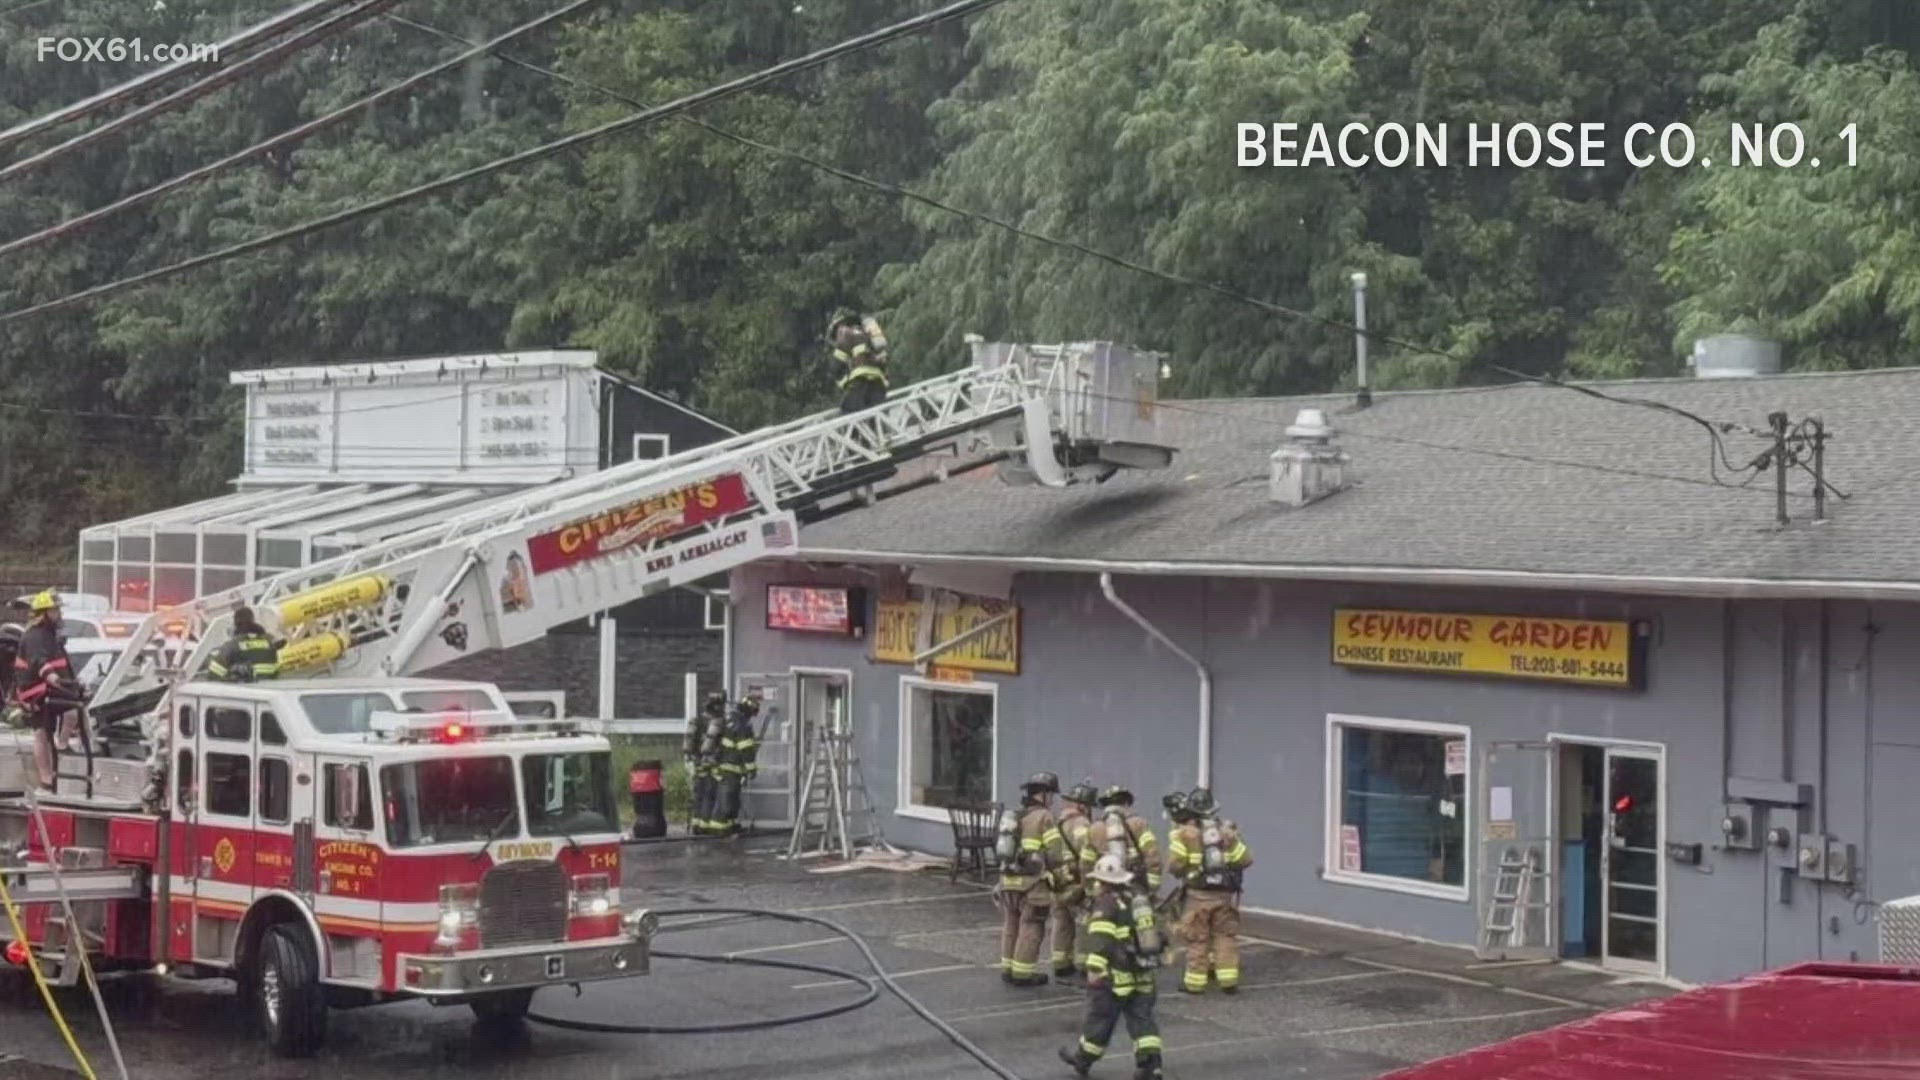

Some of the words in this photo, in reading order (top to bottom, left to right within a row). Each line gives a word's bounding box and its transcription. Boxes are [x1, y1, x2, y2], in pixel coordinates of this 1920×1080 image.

[559, 483, 718, 554] CITIZEN'S
[680, 529, 748, 562] AERIALCAT
[1347, 613, 1473, 642] SEYMOUR
[1489, 620, 1613, 650] GARDEN
[1337, 644, 1386, 662] CHINESE
[1389, 647, 1464, 667] RESTAURANT
[320, 842, 378, 864] CITIZEN'S
[589, 852, 617, 868] T-14
